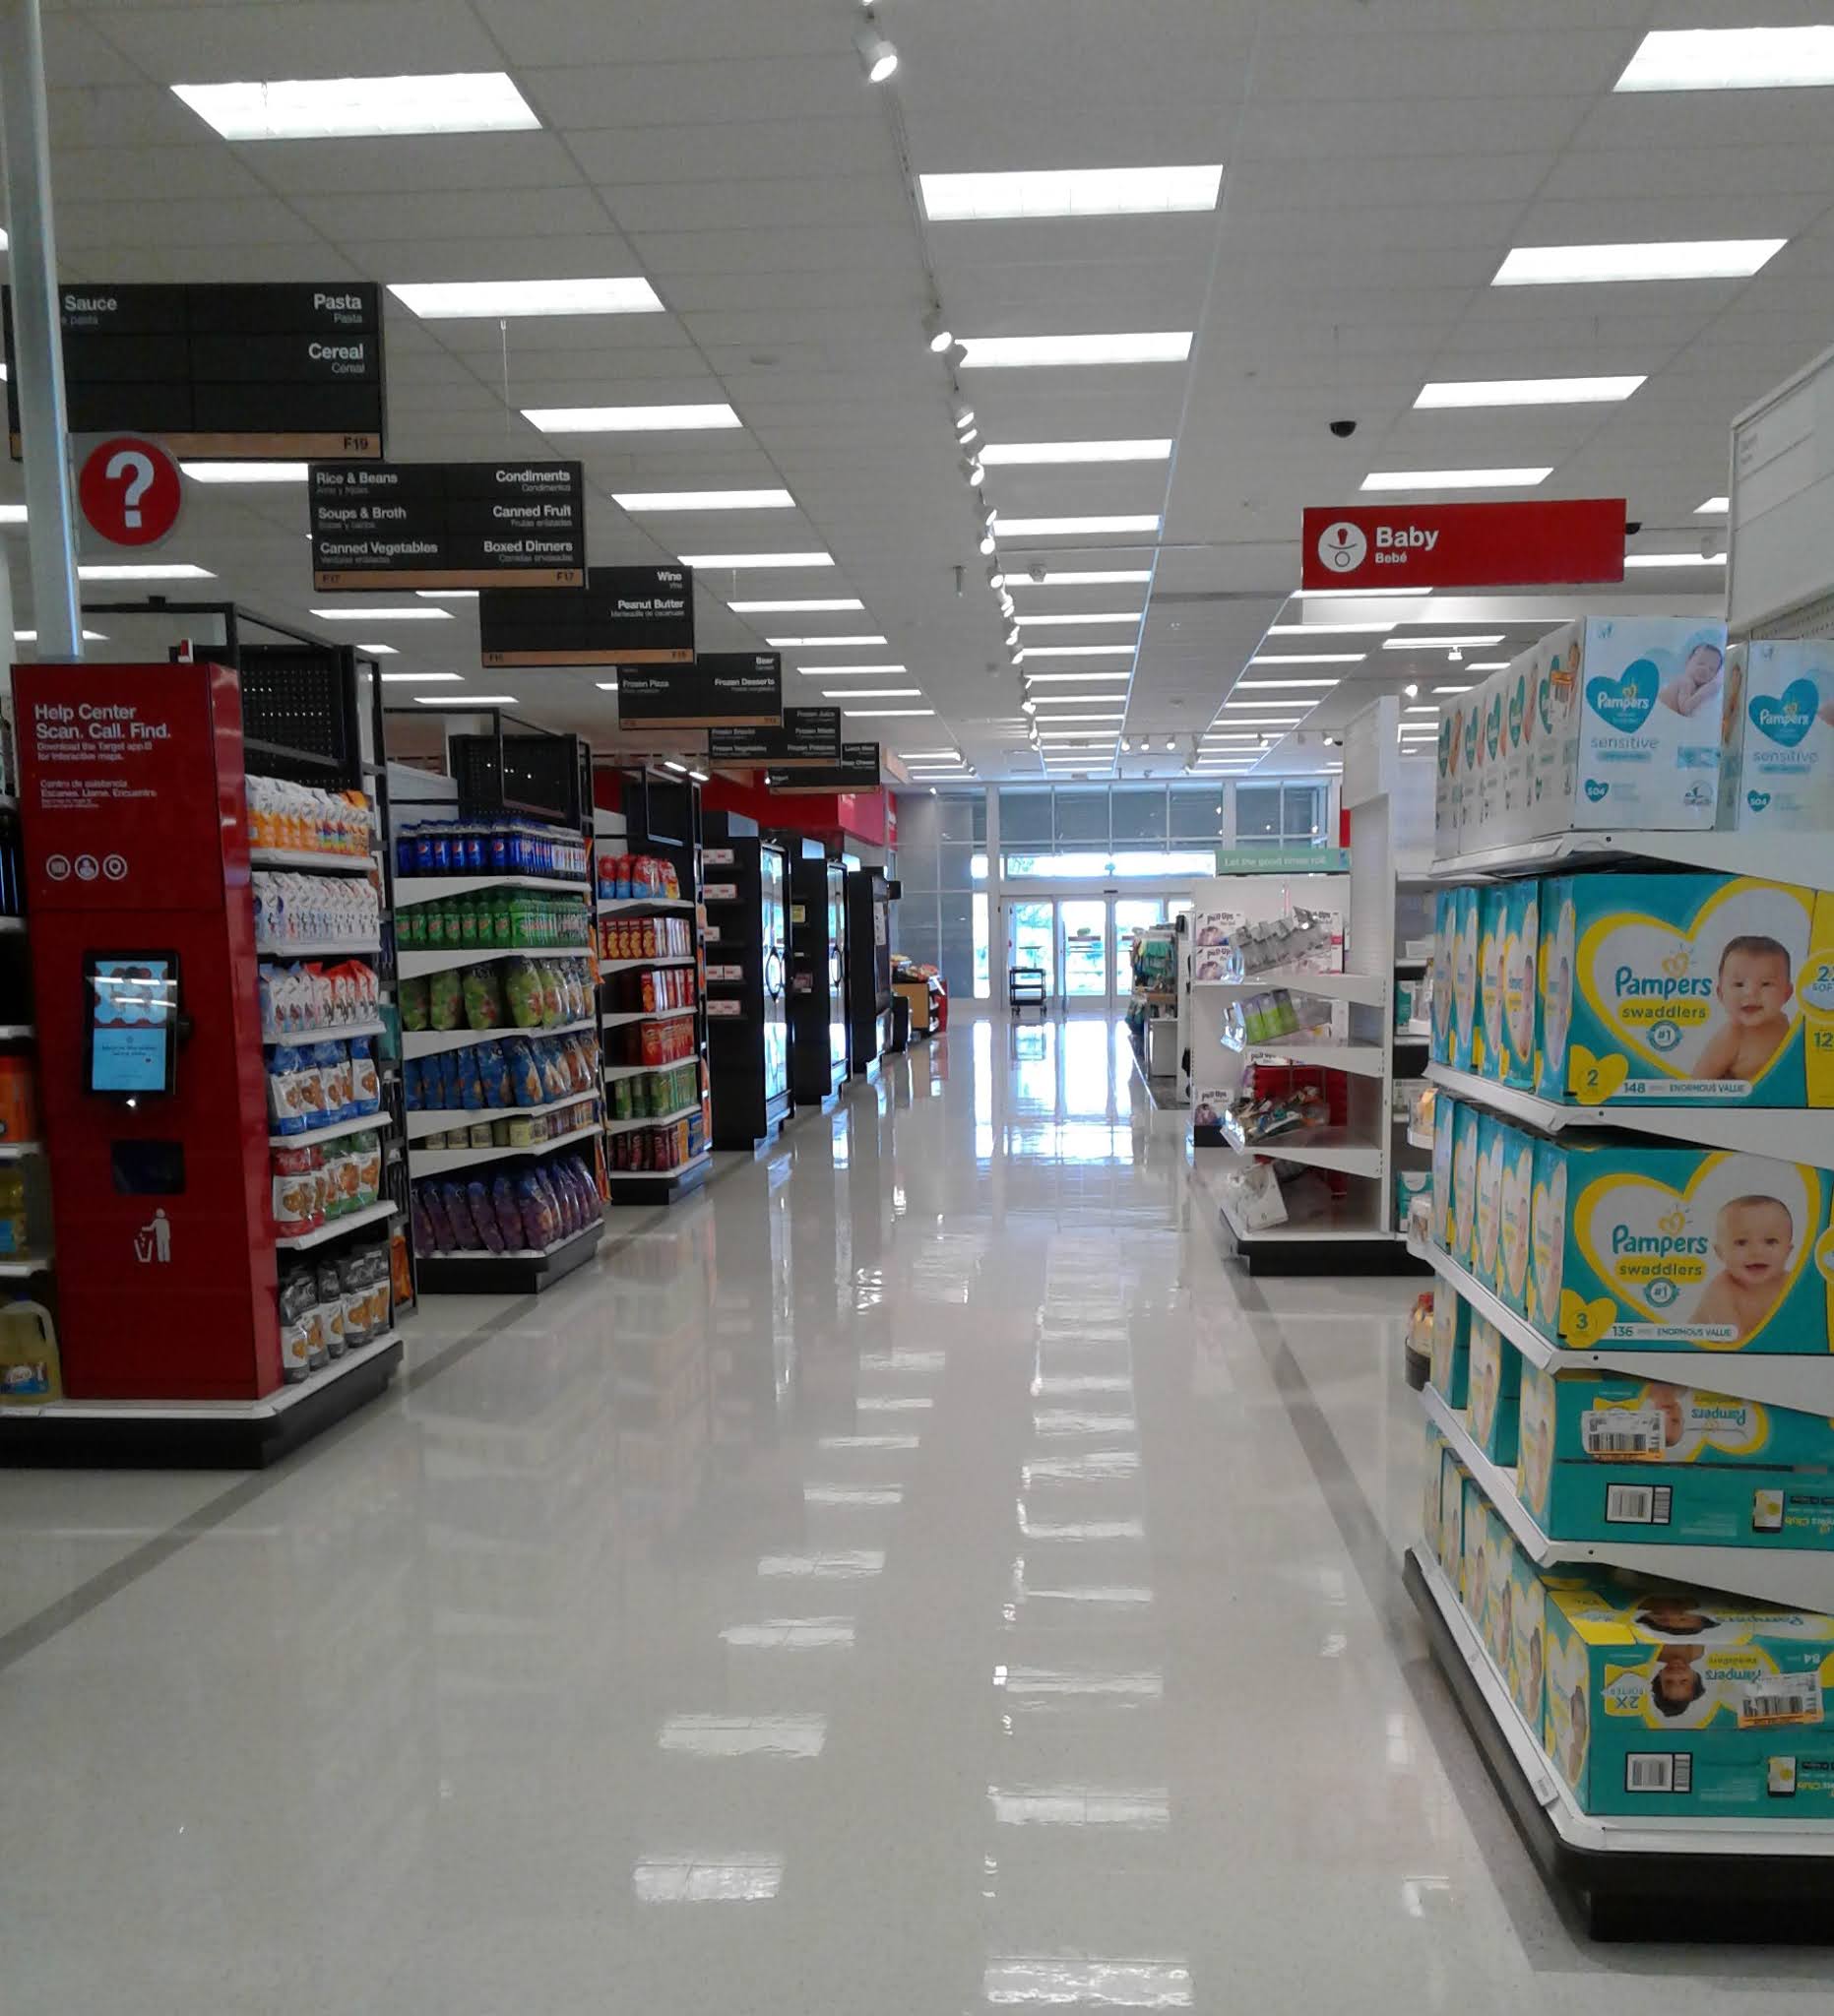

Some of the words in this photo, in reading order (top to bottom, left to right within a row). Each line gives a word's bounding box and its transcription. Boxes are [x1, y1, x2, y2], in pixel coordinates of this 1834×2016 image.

[65, 296, 117, 311] Sauce
[314, 293, 361, 310] Pasta
[309, 344, 364, 360] Cereal
[332, 362, 365, 373] Cereal
[344, 437, 368, 451] F19
[316, 472, 345, 484] Rice
[347, 472, 356, 484] &
[359, 472, 398, 484] Beans
[495, 470, 571, 482] Condiments
[318, 507, 357, 521] Soups
[360, 508, 369, 519] &
[372, 507, 407, 520] Broth
[492, 505, 541, 518] Canned
[543, 504, 571, 517] Fruit
[1376, 526, 1439, 551] Baby
[320, 542, 368, 554] Canned
[369, 541, 438, 555] Vegetables
[483, 540, 523, 553] Boxed
[525, 540, 573, 552] Dinners
[1375, 551, 1408, 564] Bebé
[658, 571, 682, 582] Wine
[617, 598, 652, 610] Peanut
[654, 598, 684, 608] Butter
[1597, 691, 1650, 712] Pampers
[34, 704, 74, 723] Help
[78, 704, 137, 721] Center
[1759, 709, 1808, 727] Pampers
[36, 724, 84, 739] Scan.
[89, 723, 125, 739] Call.
[130, 724, 171, 739] Find.
[1590, 735, 1661, 750] sensitive
[1752, 750, 1818, 764] sensitive
[1614, 966, 1713, 1000] Pampers
[1621, 1005, 1706, 1019] swaddlers
[1587, 1069, 1599, 1086] 2
[1623, 1082, 1646, 1095] 148
[1670, 1083, 1716, 1094] ENORMOUS
[1717, 1083, 1744, 1094] VALUE
[1612, 1225, 1708, 1258] Pampers
[1619, 1263, 1702, 1277] swaddlers
[1576, 1313, 1588, 1329] 3
[1612, 1325, 1633, 1337] 136
[1657, 1327, 1703, 1337] ENORMOUS
[1705, 1327, 1733, 1337] VALUE
[1691, 1407, 1746, 1426] Pampers
[1615, 1695, 1639, 1710] 2X
